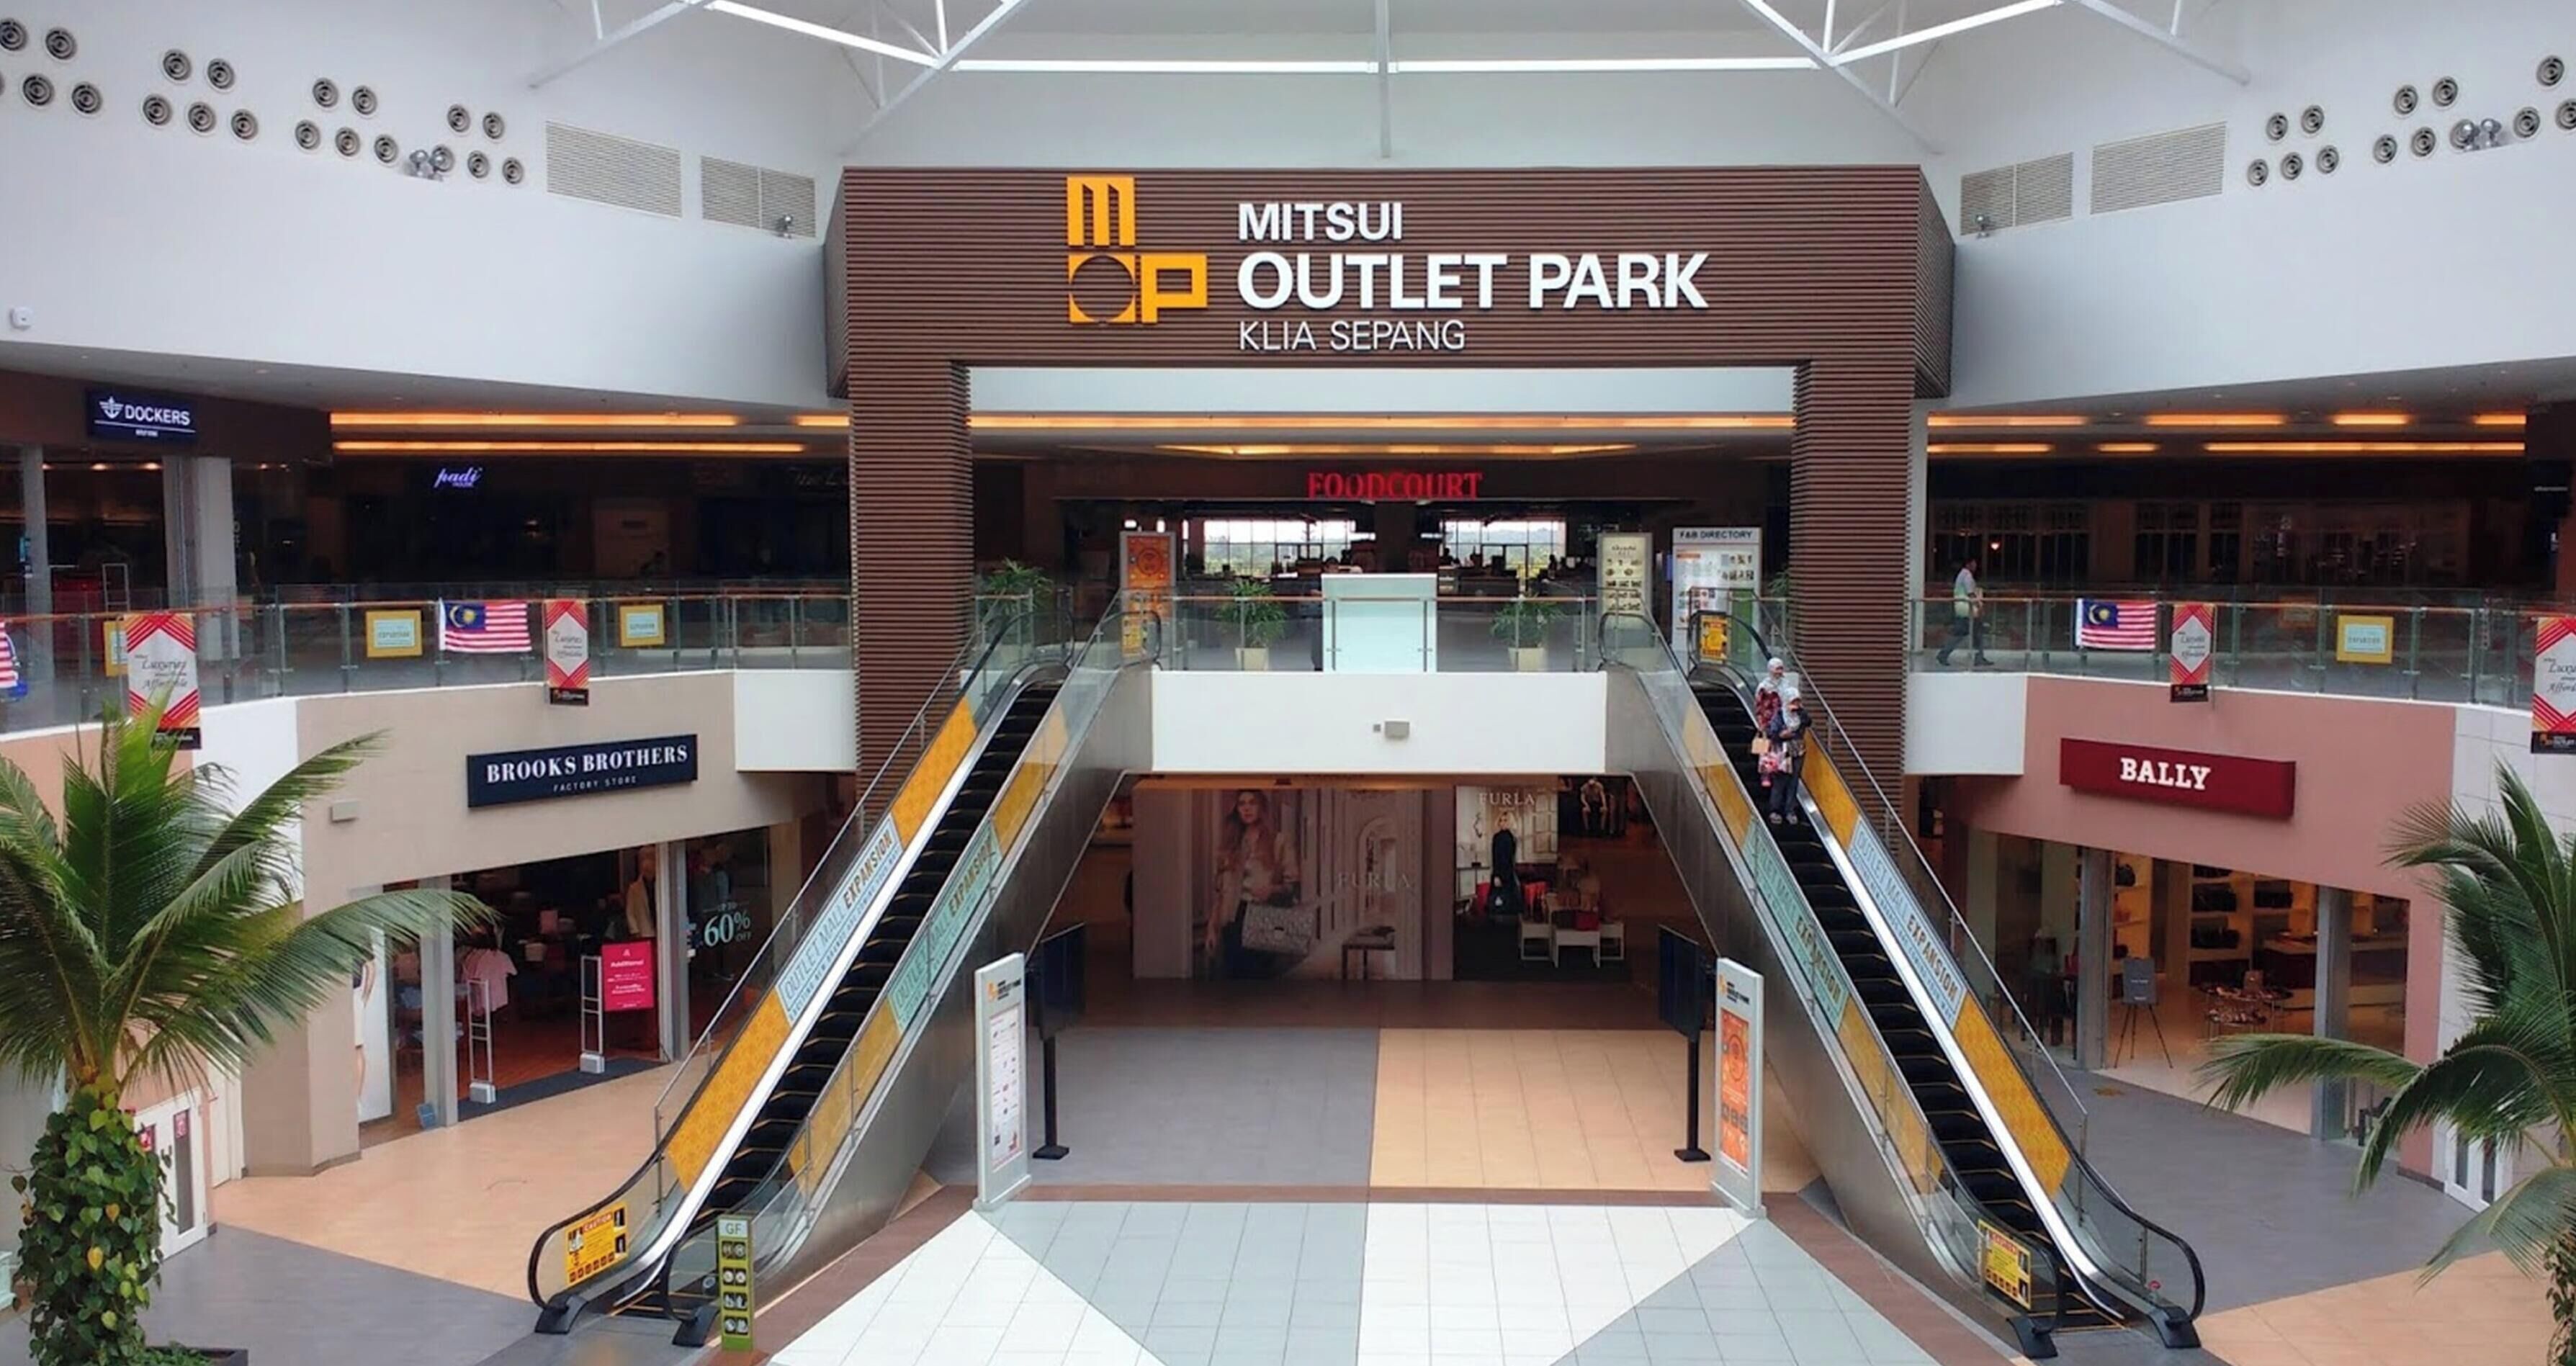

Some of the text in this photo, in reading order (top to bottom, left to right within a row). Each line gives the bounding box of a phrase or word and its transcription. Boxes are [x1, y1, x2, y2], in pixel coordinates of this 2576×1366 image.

[1237, 202, 1403, 241] MITSUI
[1237, 251, 1710, 310] OUTLET PARK
[1238, 320, 1466, 351] KLIA SEPANG
[125, 404, 191, 426] DOCKERS
[1307, 472, 1483, 498] FOODCOURT
[1700, 530, 1753, 539] DIRECTORY
[486, 745, 688, 783] BROOKS BROTHERS
[2120, 757, 2212, 791] BALLY
[553, 775, 637, 792] FACTORY STORE
[1479, 791, 1535, 806] FURLA
[842, 828, 893, 910] EXPANSION
[704, 911, 751, 948] 60%
[1906, 912, 1959, 1003] EXPANSION
[725, 1223, 742, 1235] GF
